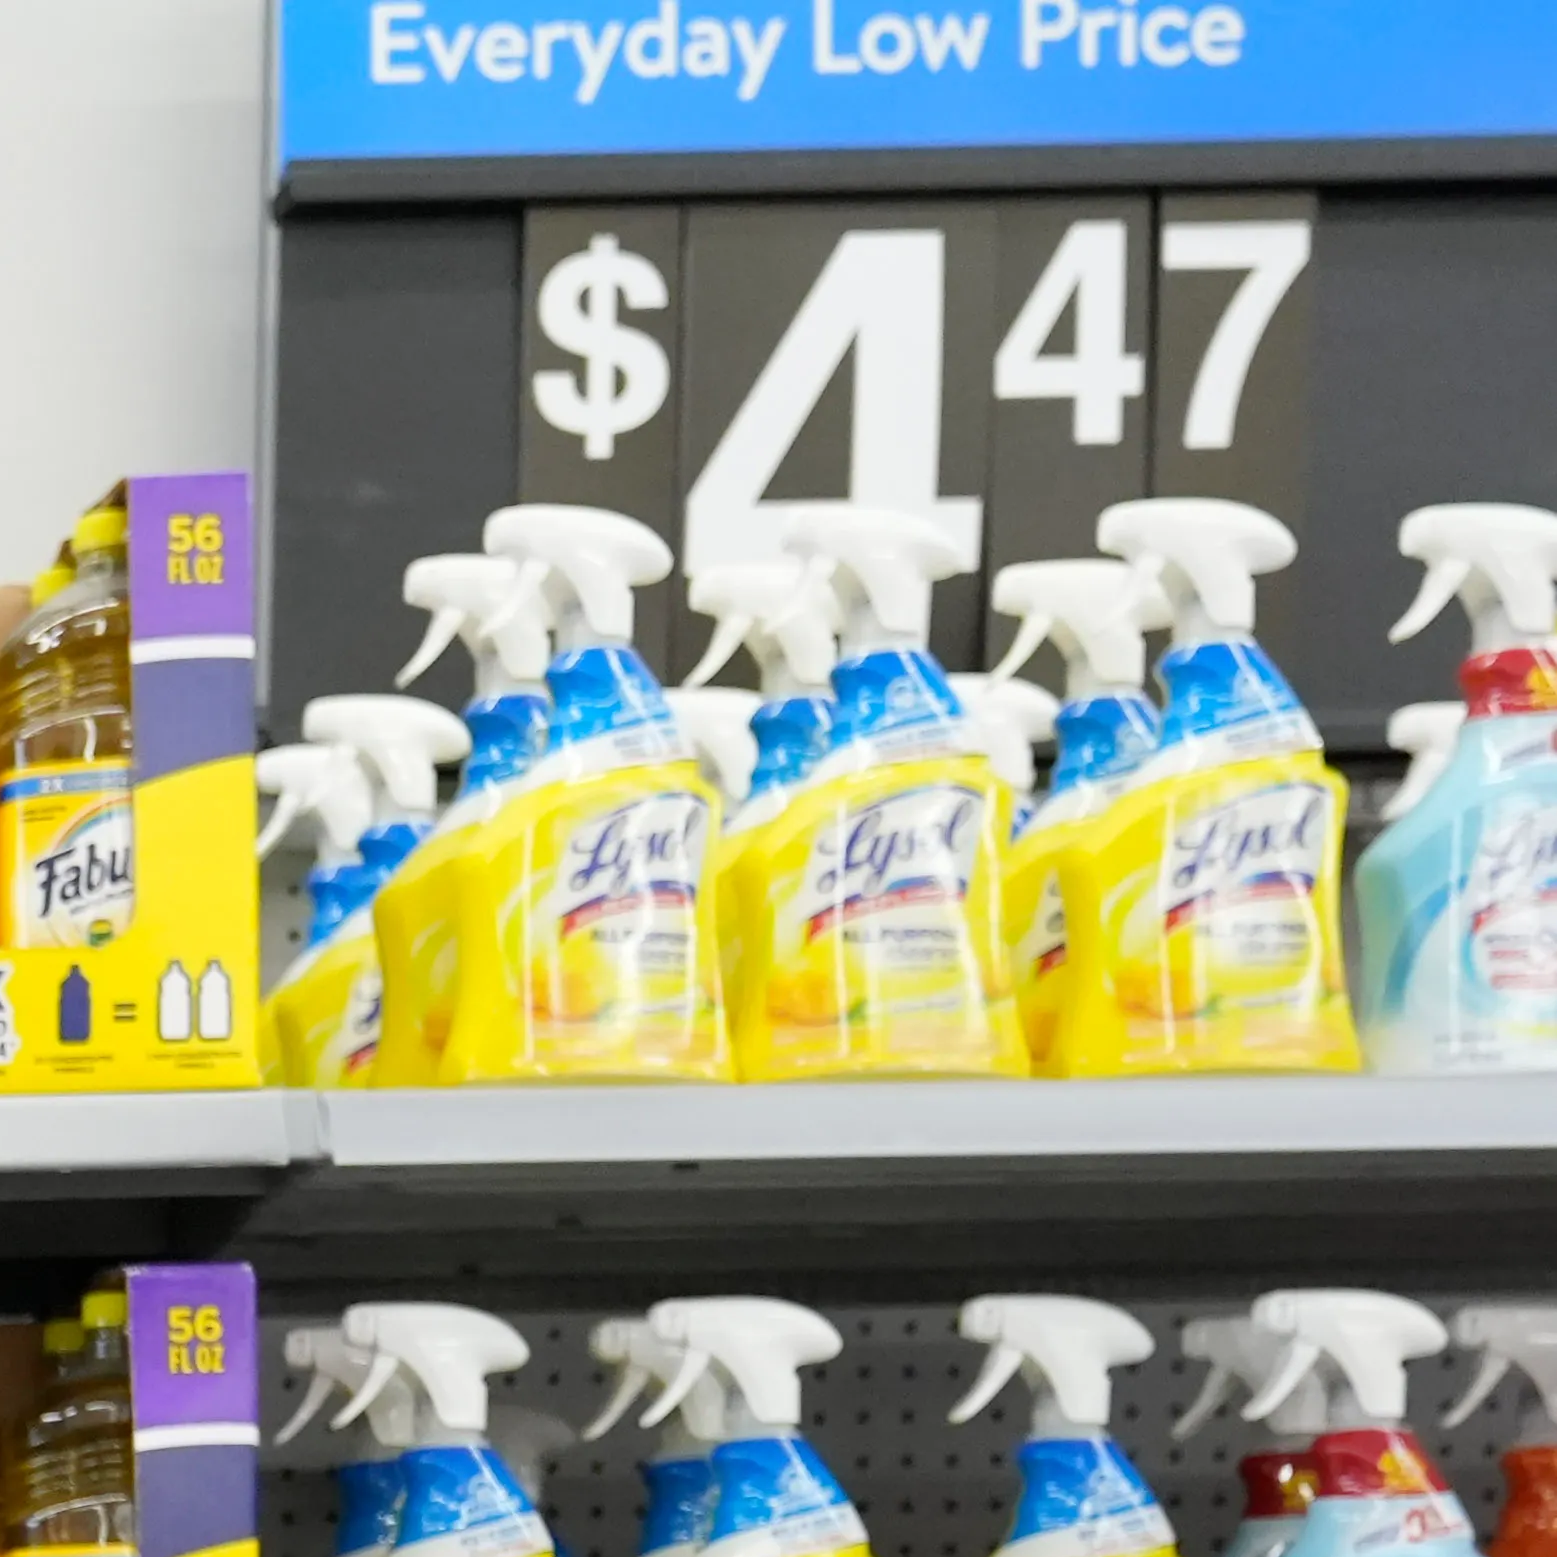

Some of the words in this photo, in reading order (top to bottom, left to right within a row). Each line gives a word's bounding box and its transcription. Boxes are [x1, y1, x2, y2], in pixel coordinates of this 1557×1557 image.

[369, 0, 782, 104] Everyday
[812, 0, 989, 75] Low
[1020, 0, 1246, 69] Price
[167, 515, 223, 553] 56
[167, 554, 196, 584] FL
[197, 554, 225, 584] OZ
[570, 805, 699, 898] Lysol
[816, 800, 972, 898] Lysol
[1174, 799, 1323, 888] Lysol
[35, 845, 131, 919] Fabu
[167, 1307, 222, 1344] 56
[167, 1344, 194, 1374] FL
[195, 1344, 225, 1374] OZ
